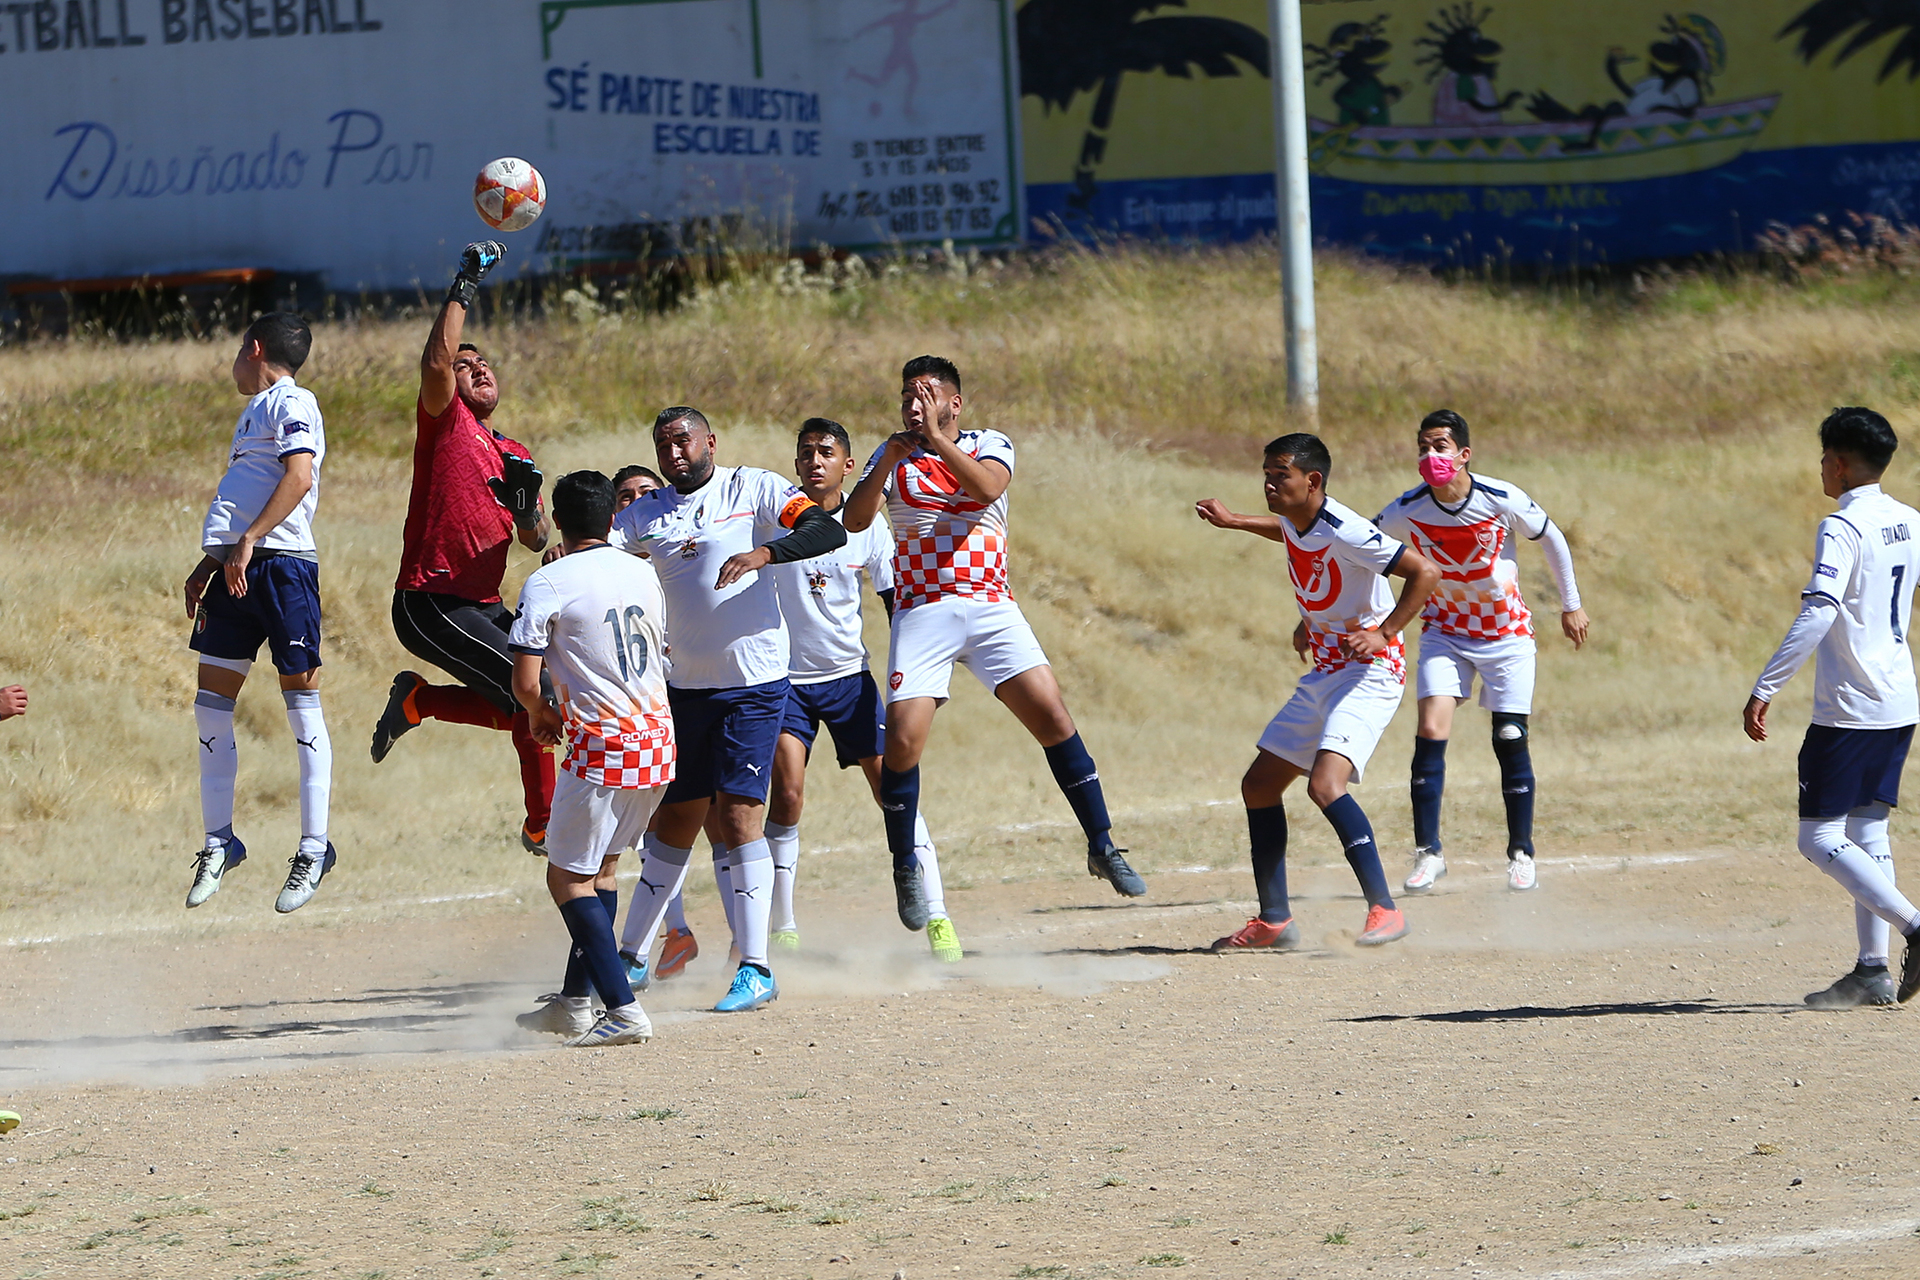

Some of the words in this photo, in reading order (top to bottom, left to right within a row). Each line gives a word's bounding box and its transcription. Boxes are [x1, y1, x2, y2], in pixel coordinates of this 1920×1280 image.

[0, 0, 147, 53] TBALL
[162, 0, 383, 45] BASEBALL
[545, 61, 590, 112] SÉ
[599, 72, 684, 117] PARTE
[690, 82, 723, 118] DE
[728, 85, 822, 124] NUESTRA
[45, 121, 308, 201] Diseñado
[654, 122, 782, 156] ESCUELA
[794, 128, 821, 156] DE
[851, 140, 868, 159] SI
[874, 138, 928, 158] TIENES
[935, 134, 986, 155] ENTRE
[515, 487, 525, 510] 1
[786, 497, 810, 516] CAP
[1890, 564, 1906, 644] 1
[603, 604, 648, 683] 16
